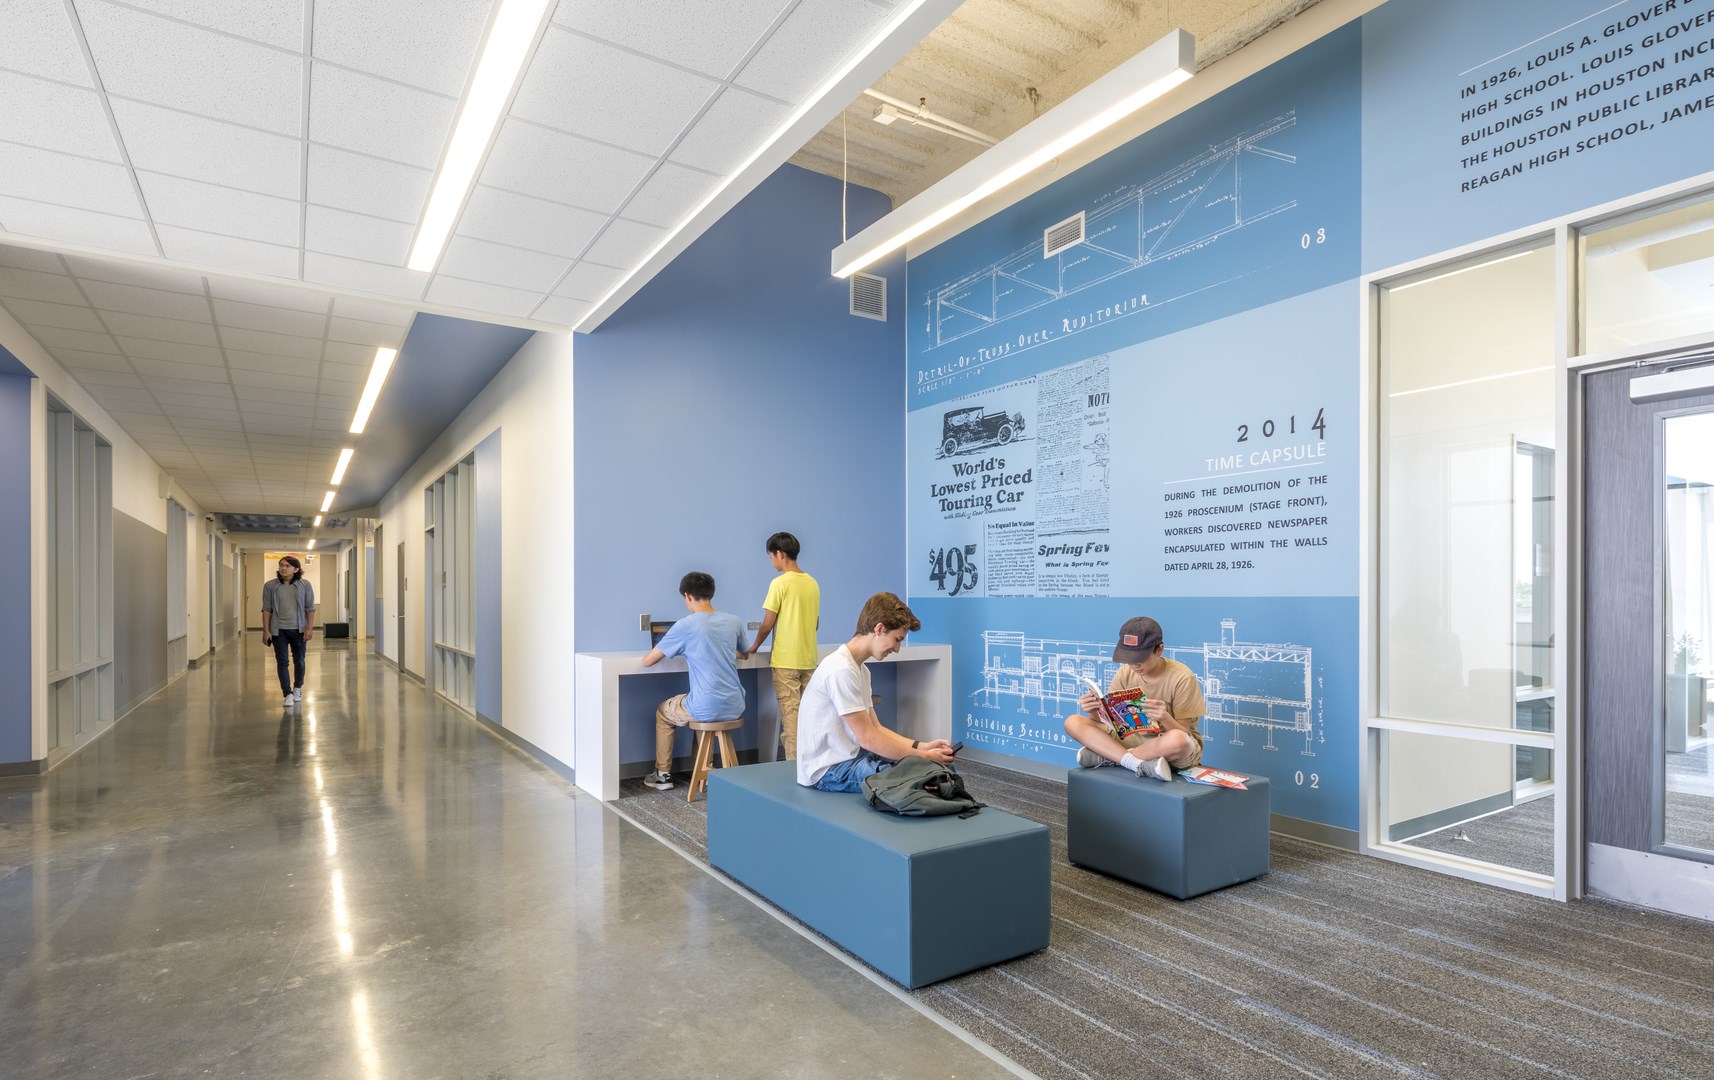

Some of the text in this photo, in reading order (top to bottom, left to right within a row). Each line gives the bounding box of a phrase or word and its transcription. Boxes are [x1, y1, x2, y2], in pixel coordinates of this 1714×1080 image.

[1461, 0, 1676, 99] IN 1926, LOUIS A. GLOVER
[1461, 100, 1498, 122] HIGH
[1504, 74, 1574, 105] SCHOOL.
[1581, 44, 1633, 73] LOUIS
[1461, 106, 1544, 146] BUILDINGS
[1551, 96, 1568, 111] IN
[1576, 58, 1665, 101] HOUSTON
[1461, 68, 1714, 169] THE HOUSTON PUBLIC LIBRAR
[1461, 96, 1714, 192] REAGAN HIGH SCHOOL, JAME
[1301, 228, 1325, 248] 03
[1237, 408, 1326, 442] 2014
[952, 457, 1005, 477] World's
[1206, 442, 1326, 472] TIME CAPSULE
[931, 468, 1033, 497] Lowest Priced
[1165, 475, 1328, 501] DURING THE DEMOLITION OF THE
[939, 489, 1024, 512] Touring Car
[1188, 504, 1244, 517] PROSCENIUM
[1250, 500, 1281, 512] (STAGE
[1287, 496, 1328, 508] FRONT),
[1164, 516, 1328, 536] WORKERS DISCOVERED NEWSPAPER
[1038, 542, 1109, 557] Spring Fev
[1164, 537, 1328, 554] ENCAPSULATED WITHIN THE WALLS
[929, 544, 978, 596] $495
[1164, 560, 1254, 571] DATED APRIL 28, 1926.
[967, 713, 1013, 736] Building
[1295, 770, 1319, 789] 02
